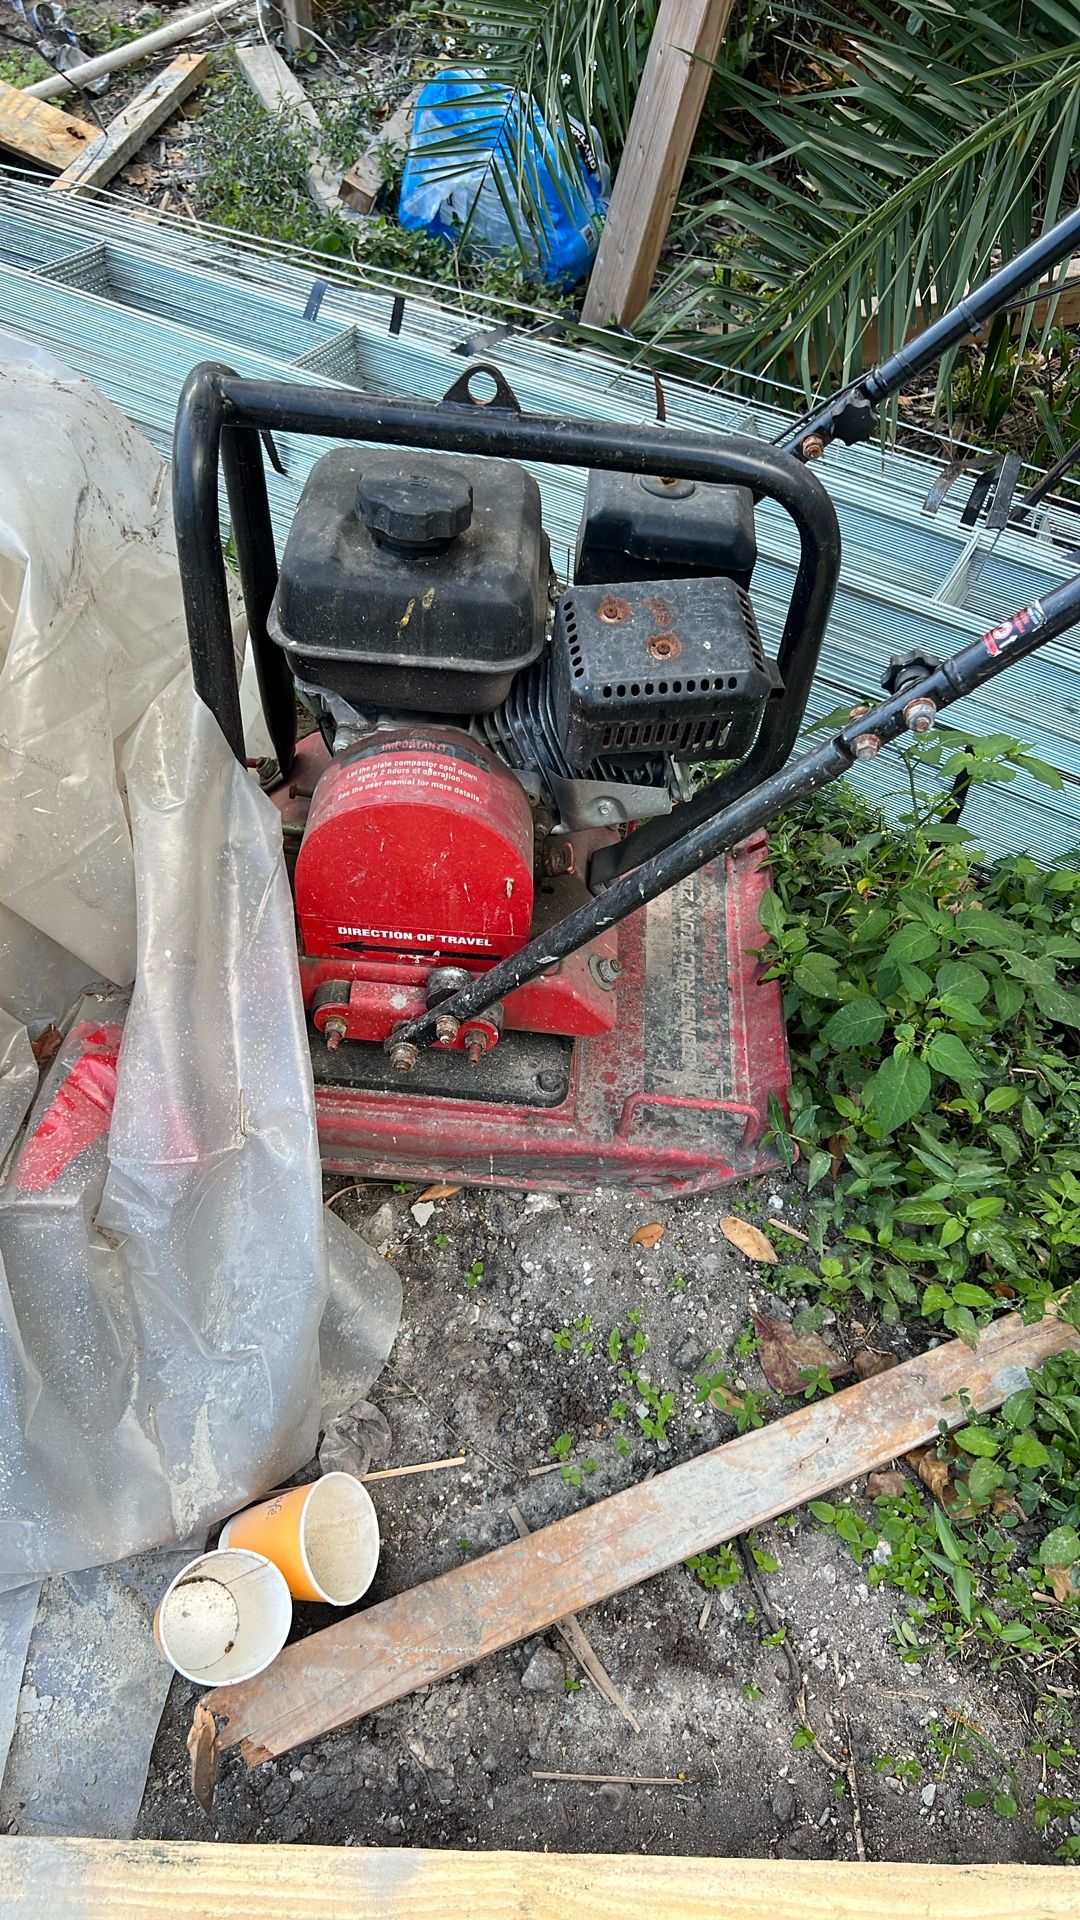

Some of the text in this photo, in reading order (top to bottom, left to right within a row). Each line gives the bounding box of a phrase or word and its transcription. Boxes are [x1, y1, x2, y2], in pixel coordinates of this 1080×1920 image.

[346, 760, 479, 783] Let the plate compactor cool down
[357, 771, 378, 782] every
[386, 767, 410, 775] hours
[412, 767, 421, 775] of
[422, 768, 464, 784] operation.
[337, 779, 483, 805] See the user manual for more details.
[338, 926, 493, 947] DIRECTION OF TRAVEL
